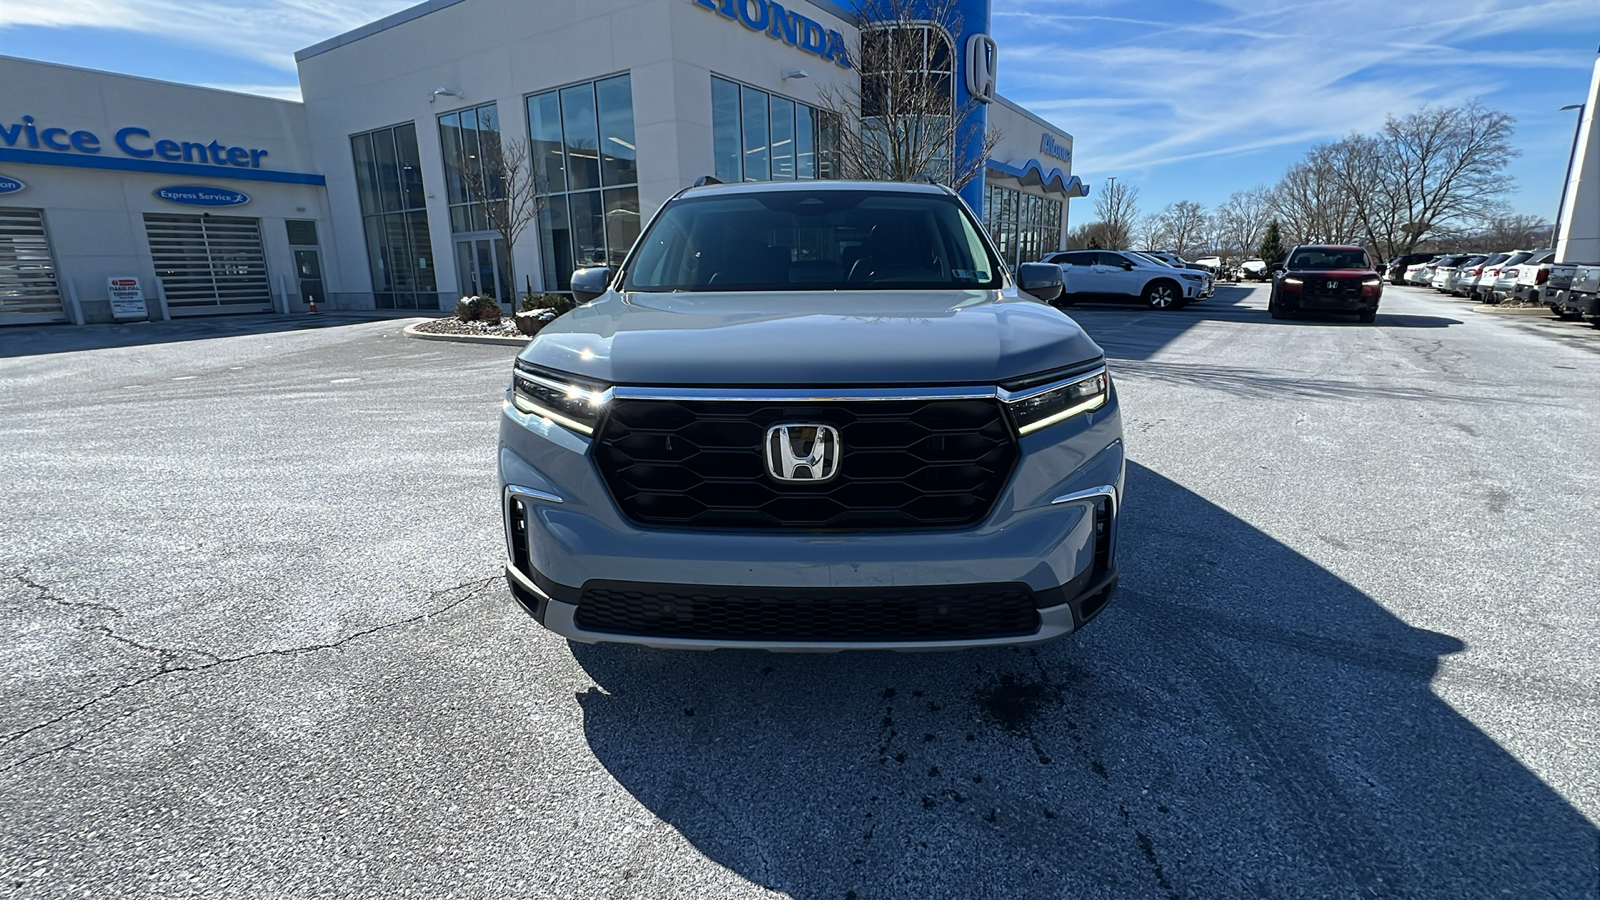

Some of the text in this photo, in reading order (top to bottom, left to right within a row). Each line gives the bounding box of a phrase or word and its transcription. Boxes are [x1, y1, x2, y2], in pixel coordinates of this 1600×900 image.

[114, 127, 268, 168] Center
[160, 190, 232, 201] Express Service
